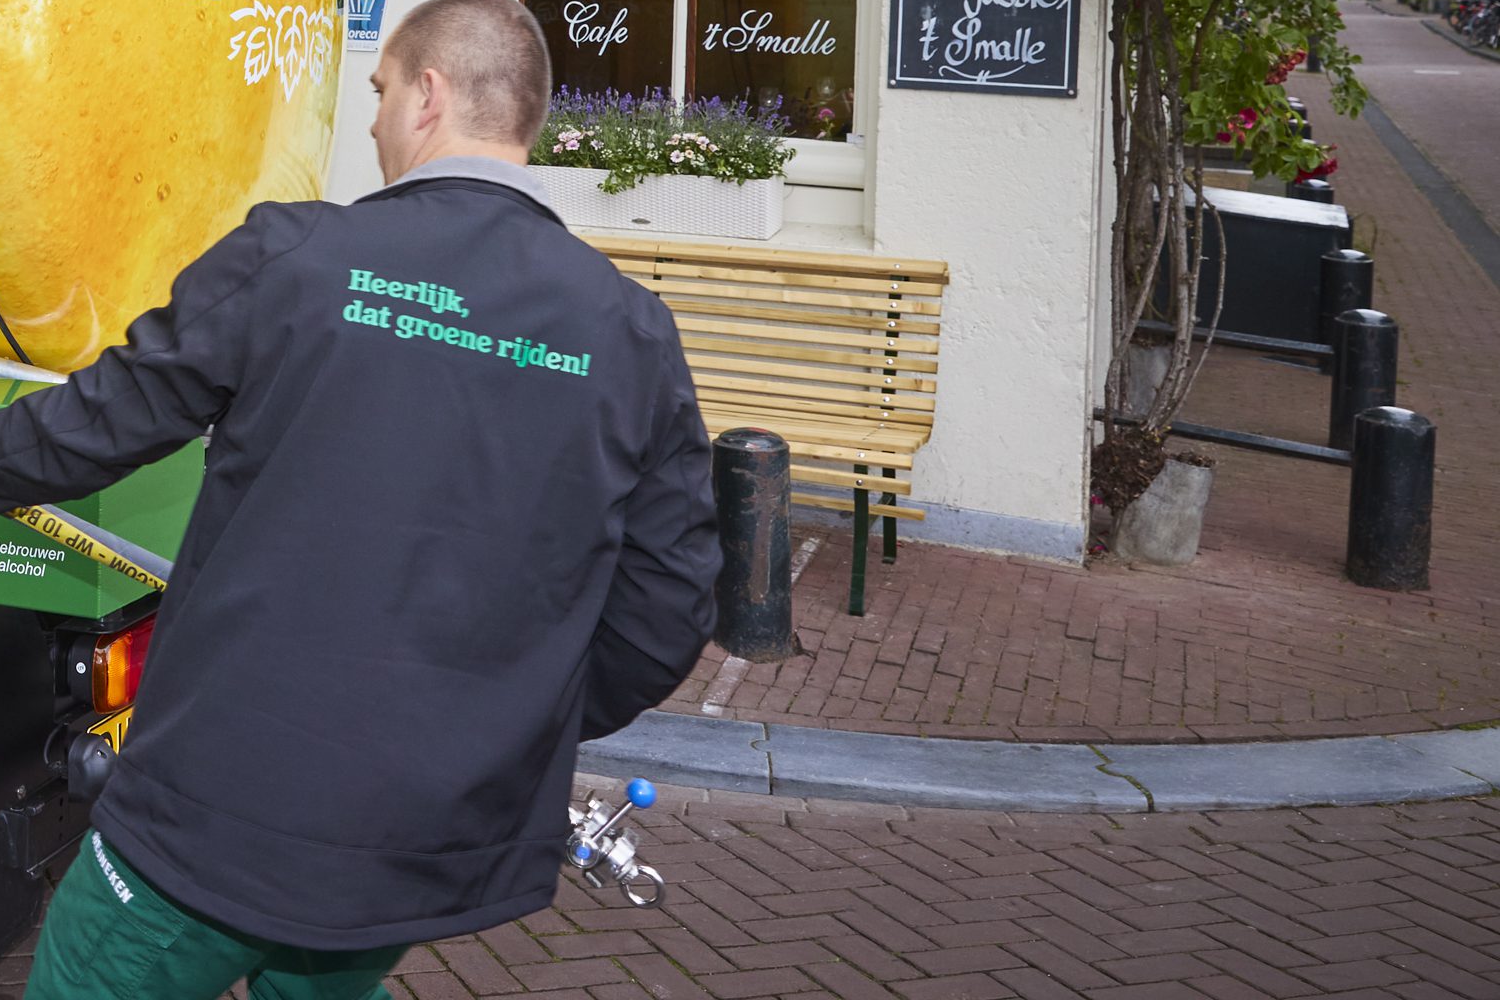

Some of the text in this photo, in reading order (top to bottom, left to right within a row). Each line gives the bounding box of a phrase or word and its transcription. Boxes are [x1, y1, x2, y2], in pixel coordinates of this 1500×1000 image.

[348, 29, 379, 40] oreca
[722, 9, 837, 56] Smalle
[944, 16, 1047, 67] Smalle
[347, 268, 470, 318] Heerlijk,
[342, 300, 593, 377] dat groene rijden!
[11, 505, 42, 527] BA
[41, 517, 64, 538] 10
[65, 533, 95, 557] WP
